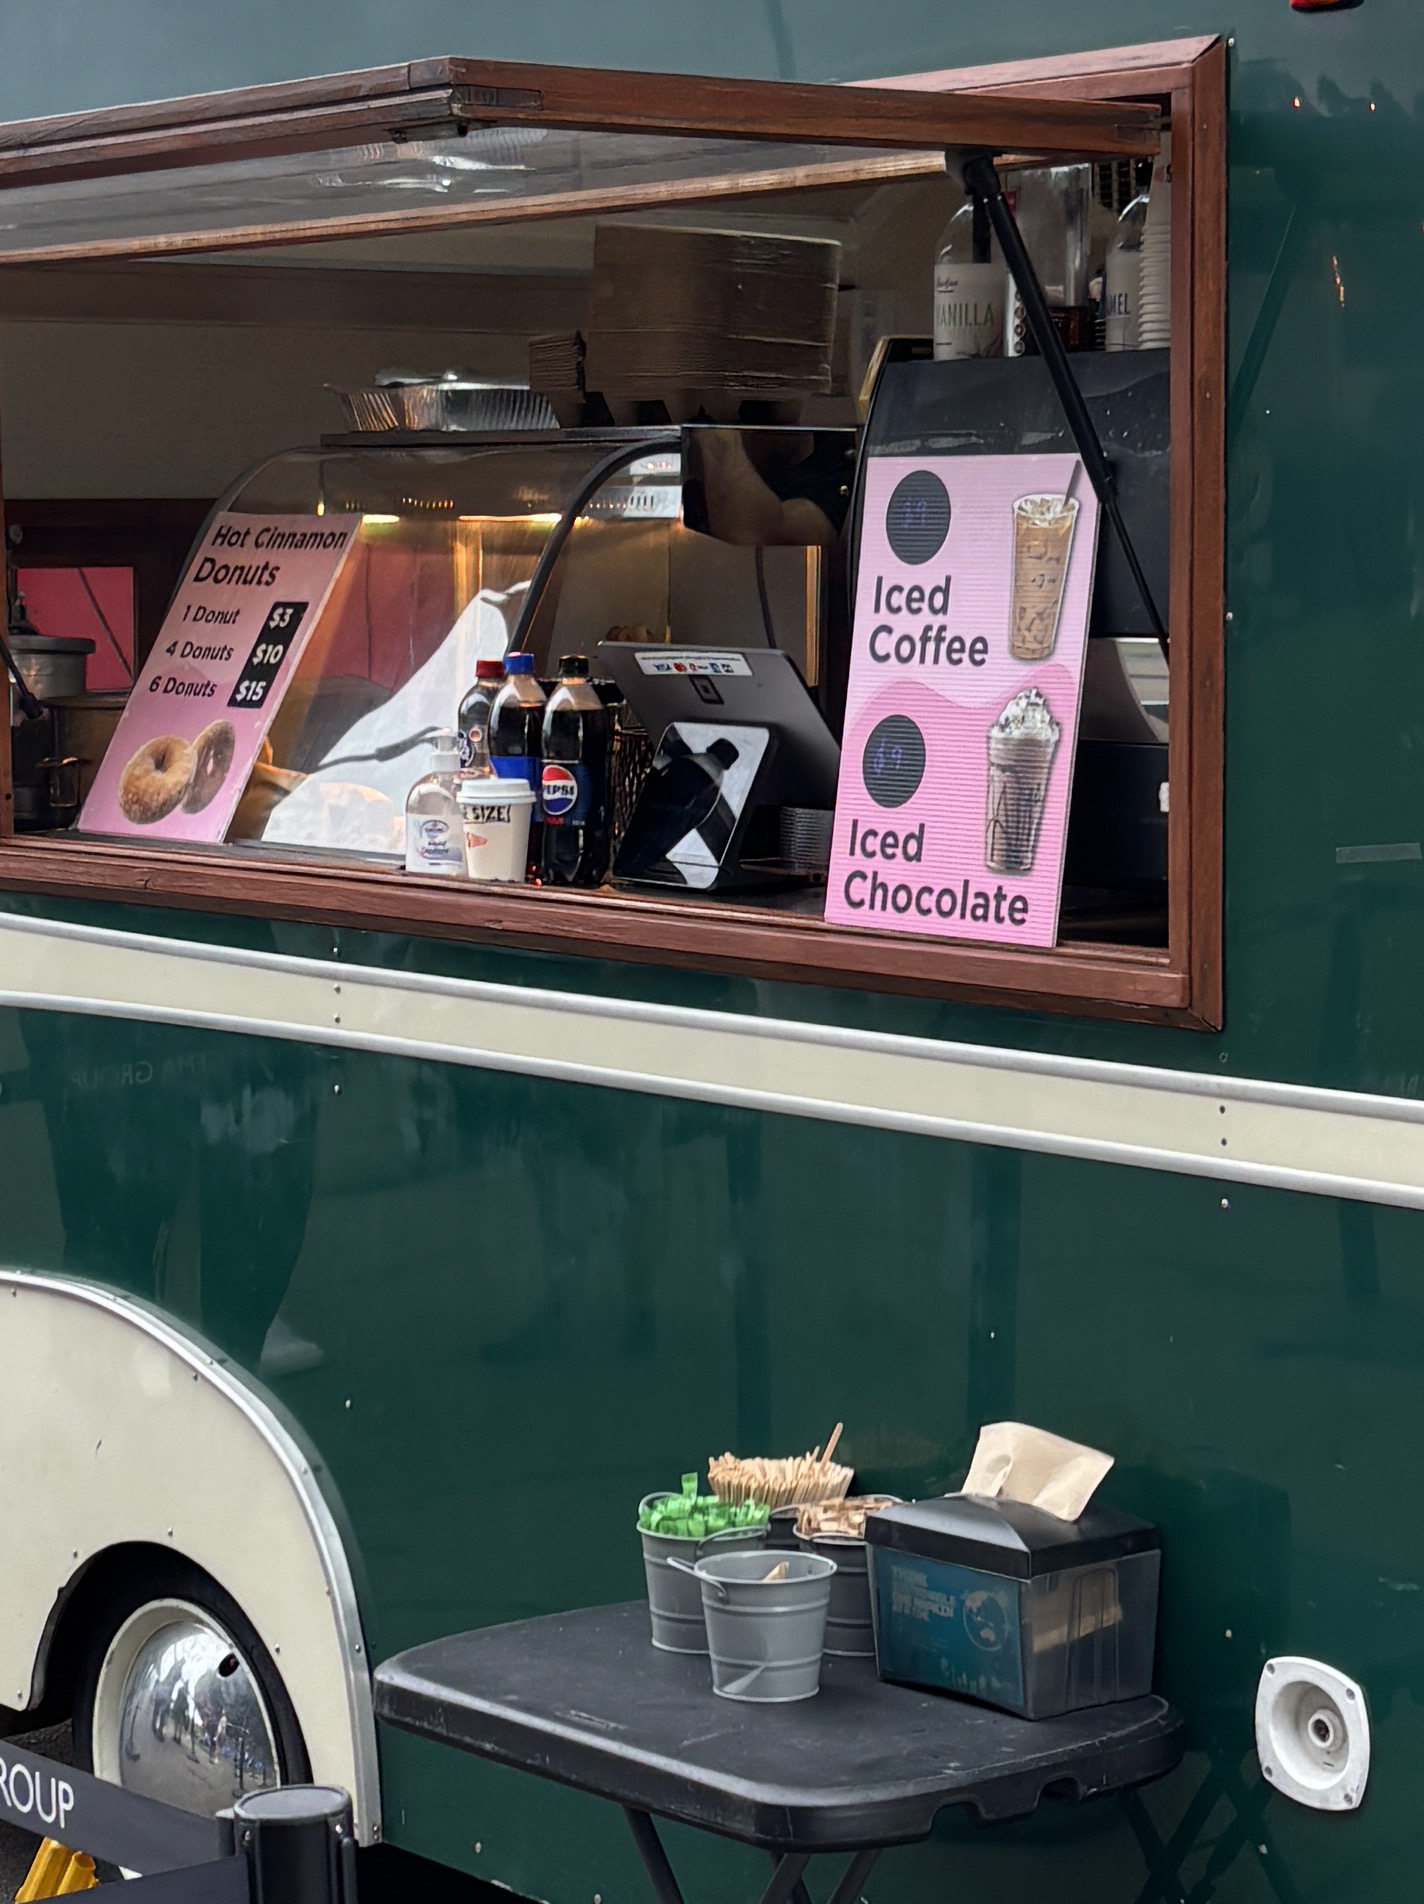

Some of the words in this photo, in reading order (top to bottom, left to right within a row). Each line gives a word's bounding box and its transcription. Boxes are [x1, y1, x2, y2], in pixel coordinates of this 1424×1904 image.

[211, 525, 251, 549] Hot
[254, 527, 349, 550] Cinnamon
[193, 557, 280, 587] Donuts
[873, 574, 952, 616] Iced
[182, 605, 191, 622] 1
[192, 605, 240, 625] Donut
[269, 607, 294, 629] $3
[166, 641, 180, 657] 4
[180, 641, 234, 661] Donuts
[252, 643, 284, 666] $10
[869, 624, 989, 667] Coffee
[149, 676, 162, 693] 6
[163, 677, 218, 697] Donuts
[235, 680, 267, 702] $15
[848, 818, 925, 863] Iced
[844, 870, 1029, 926] Chocolate
